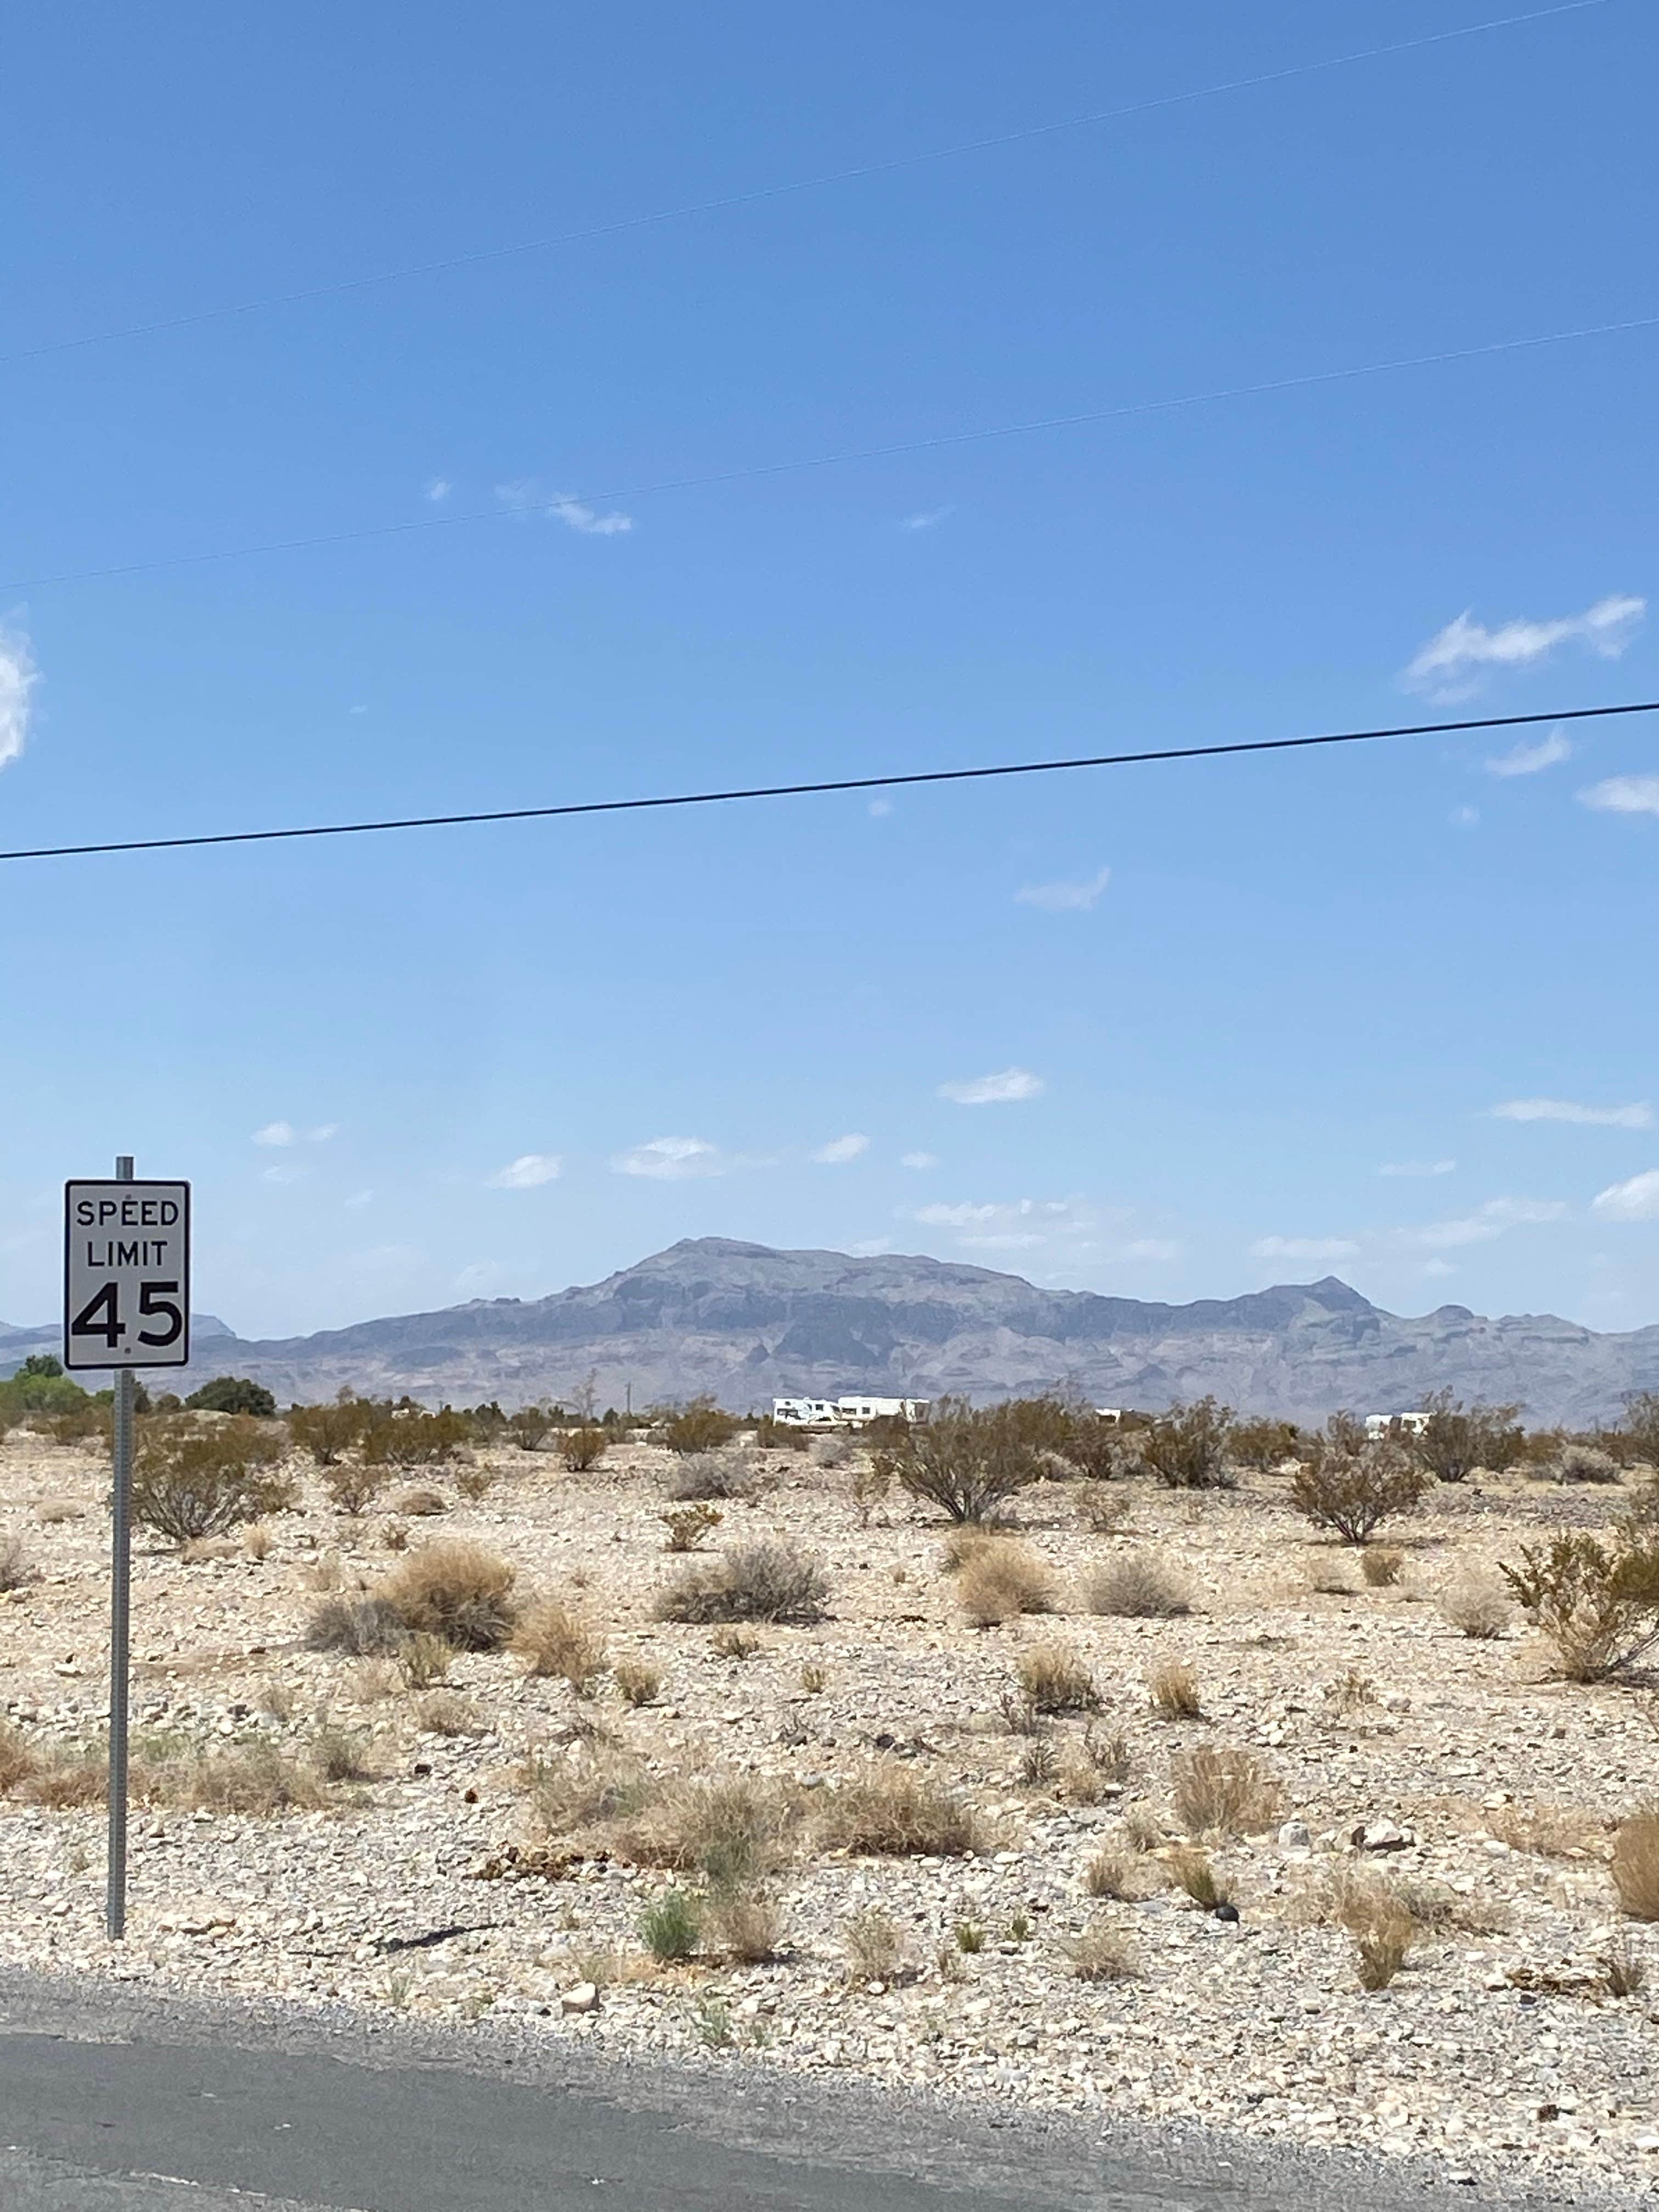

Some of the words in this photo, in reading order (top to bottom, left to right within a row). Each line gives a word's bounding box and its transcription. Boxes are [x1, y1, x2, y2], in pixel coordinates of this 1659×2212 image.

[77, 1201, 179, 1226] SPEED
[88, 1241, 167, 1267] LIMIT
[71, 1282, 182, 1348] 45
